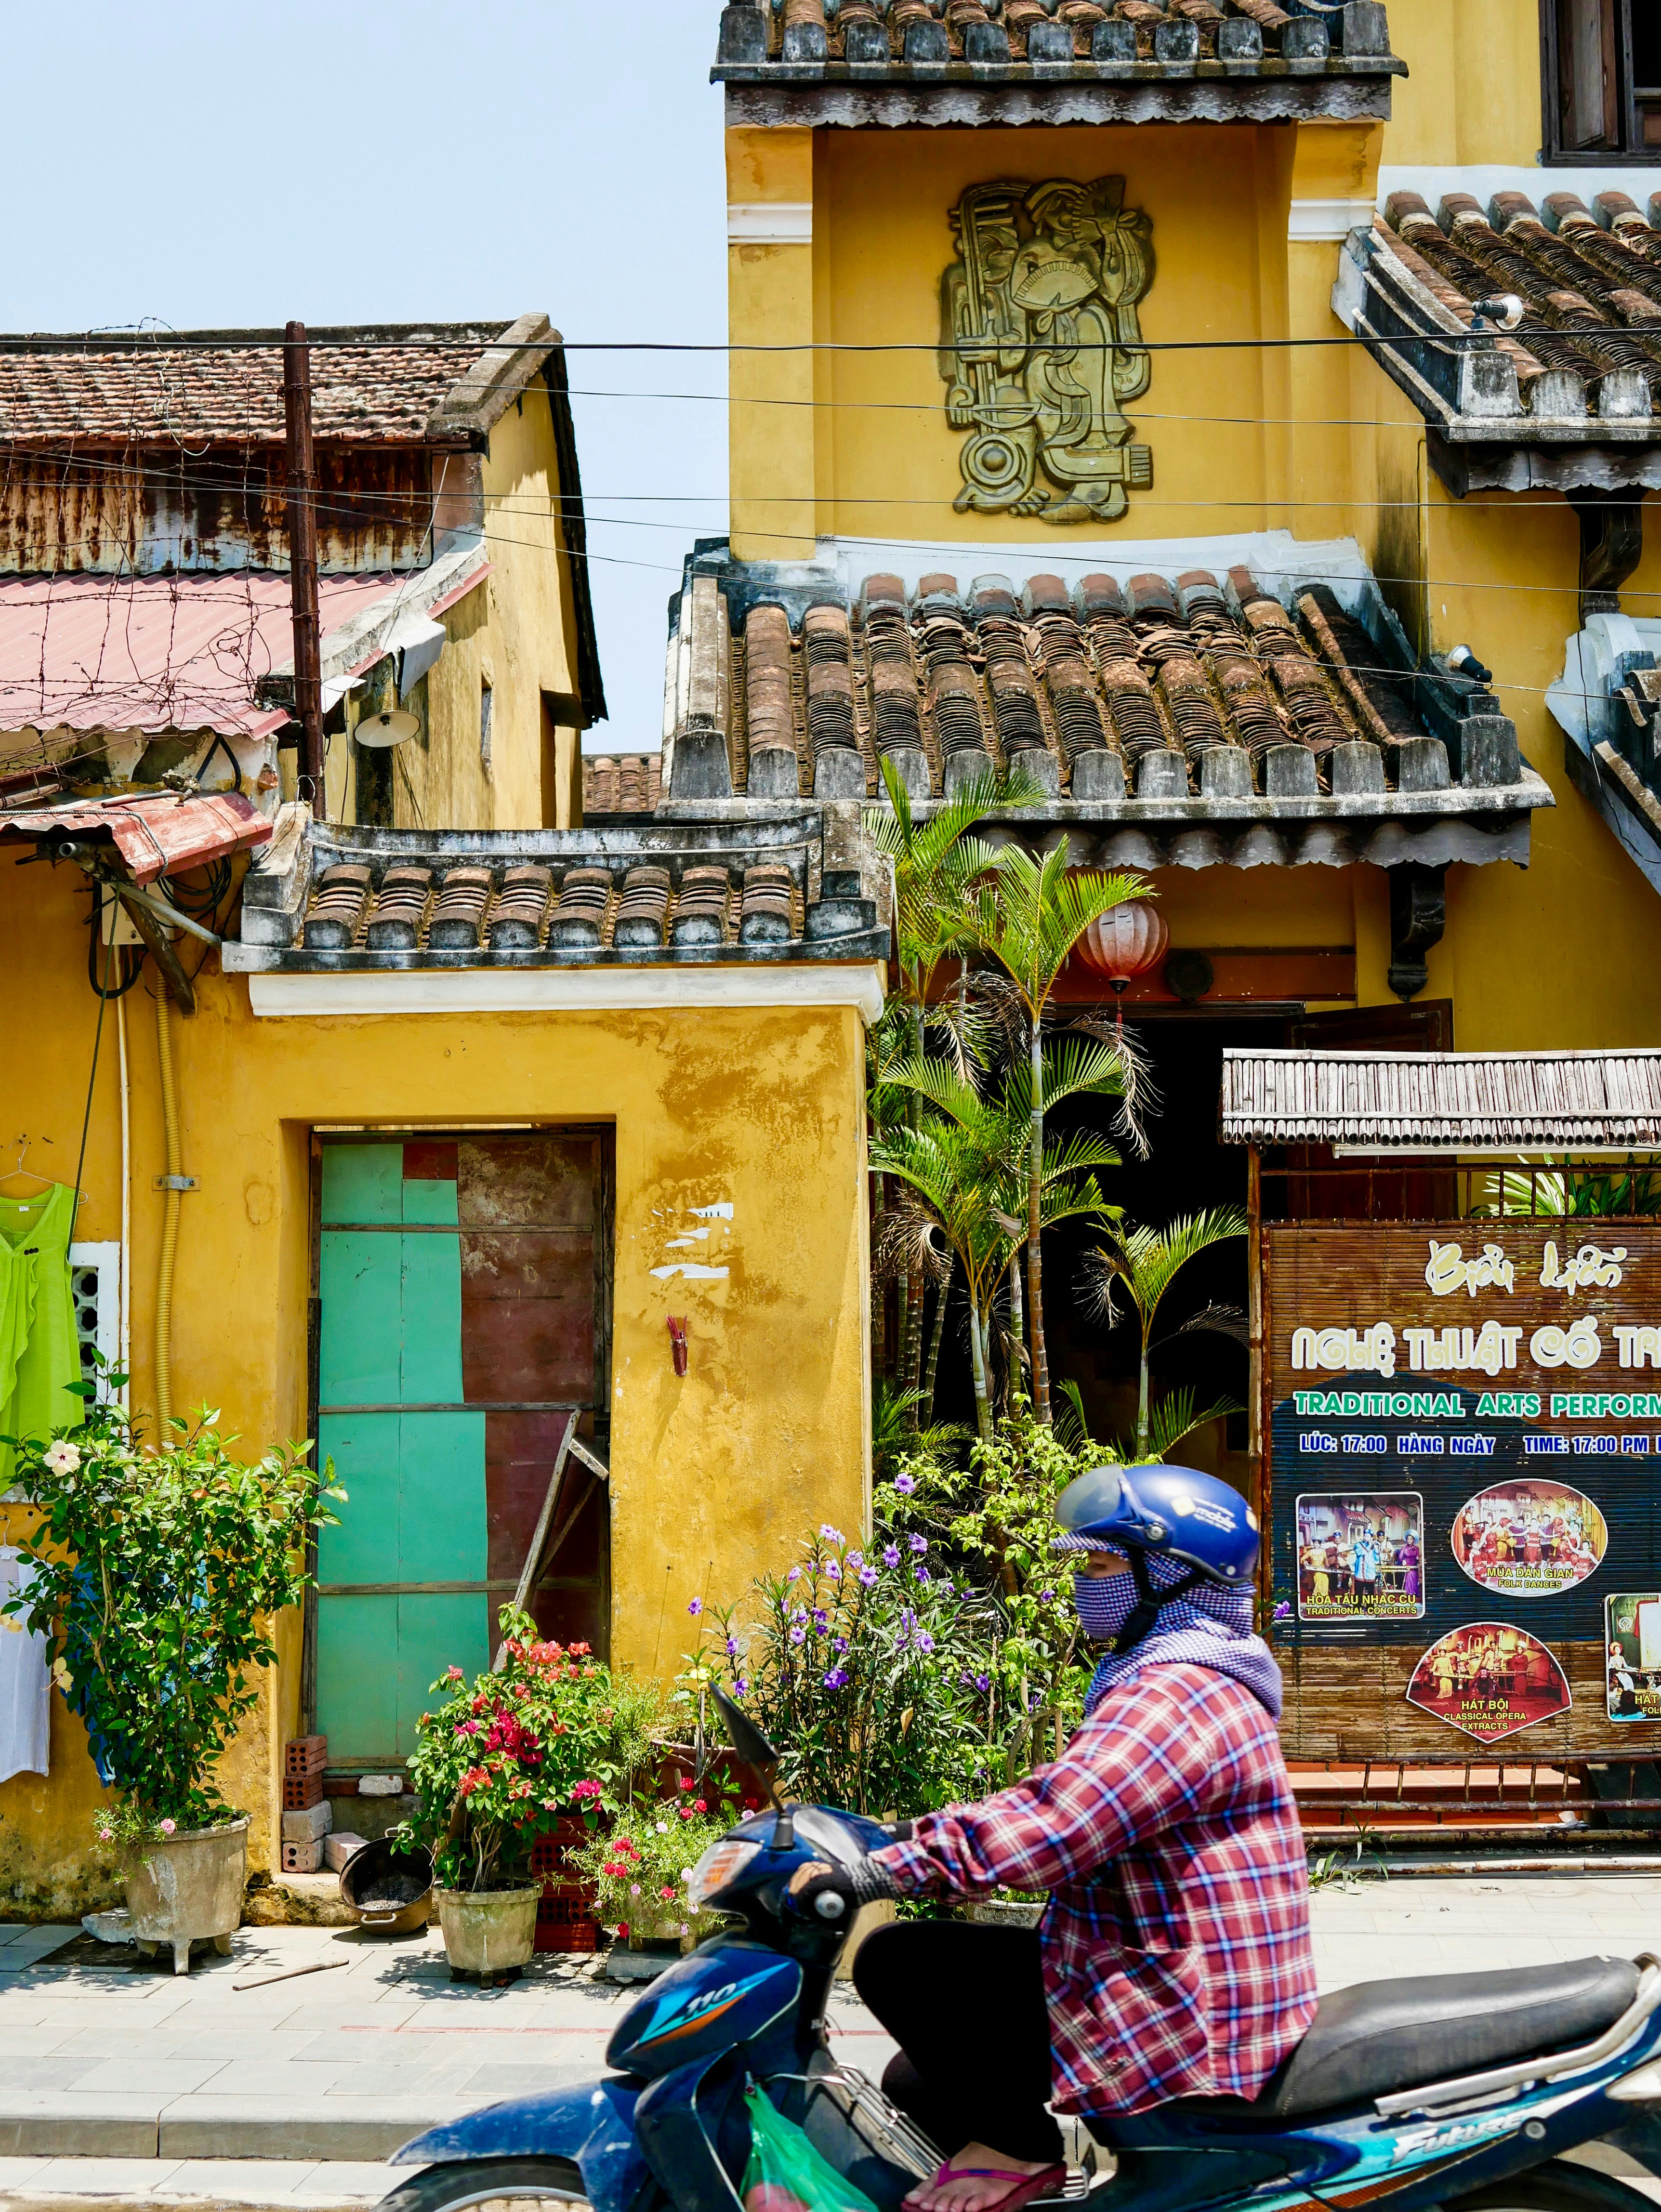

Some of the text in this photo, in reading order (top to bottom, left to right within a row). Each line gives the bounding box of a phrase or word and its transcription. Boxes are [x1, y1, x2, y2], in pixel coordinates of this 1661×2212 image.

[1294, 1392, 1465, 1417] TRADITIONAL
[1476, 1393, 1541, 1417] ARTS
[1300, 1432, 1337, 1452] LÚC:
[1342, 1435, 1386, 1453] 17:00
[1397, 1433, 1444, 1454] HÀNG
[1450, 1434, 1496, 1454] NGÀY
[1523, 1435, 1569, 1453] TIME:
[1572, 1436, 1617, 1453] 17:00
[1621, 1436, 1648, 1453] PM
[1487, 1566, 1573, 1578] MÚA DÂN GIAN
[1307, 1593, 1332, 1605] HÒA
[1362, 1594, 1395, 1606] NHẠC
[1399, 1594, 1416, 1606] CỤ
[1461, 1698, 1509, 1711] HÁT BỘI
[1635, 1692, 1658, 1704] HÁT
